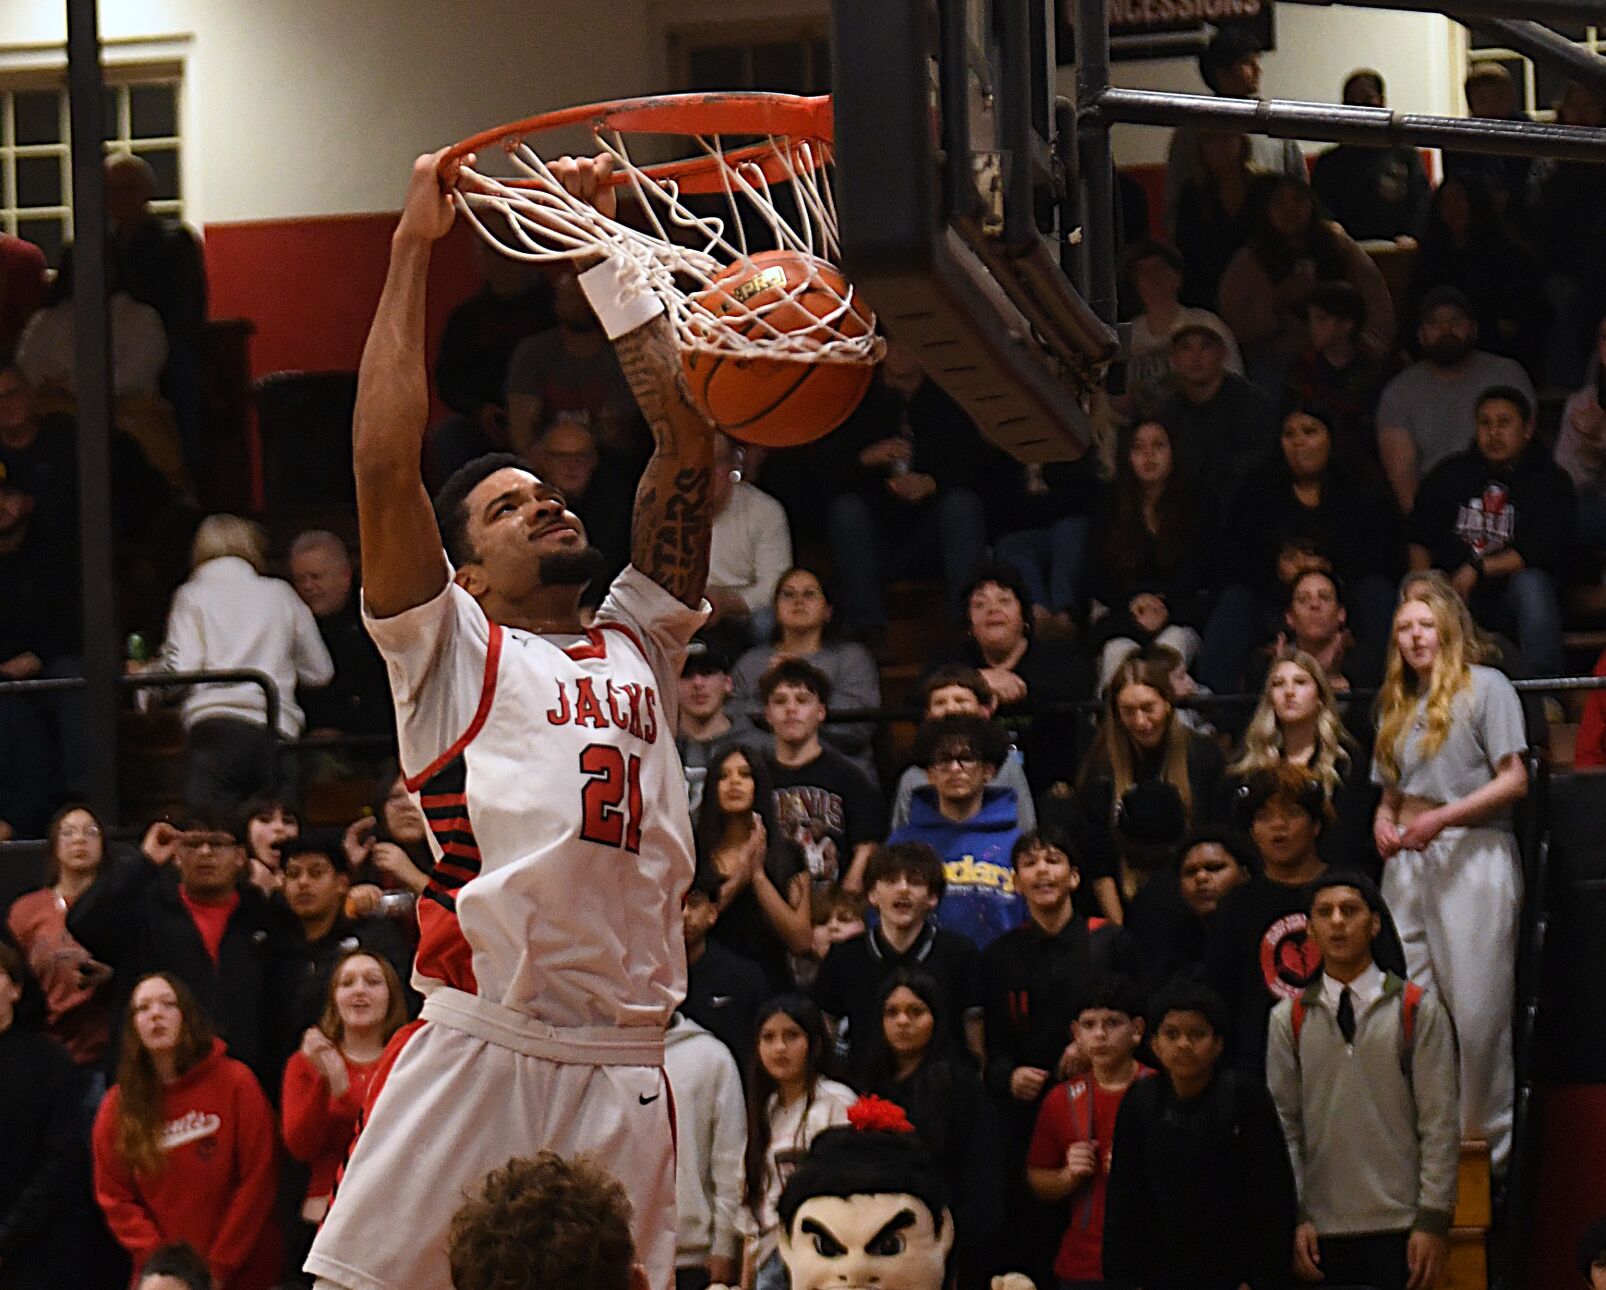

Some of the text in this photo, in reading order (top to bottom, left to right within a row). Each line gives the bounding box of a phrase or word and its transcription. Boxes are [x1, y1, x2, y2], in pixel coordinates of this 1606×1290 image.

[1063, 0, 1261, 23] NCESSIONS
[547, 675, 657, 745] JACKS
[579, 743, 643, 855] 21
